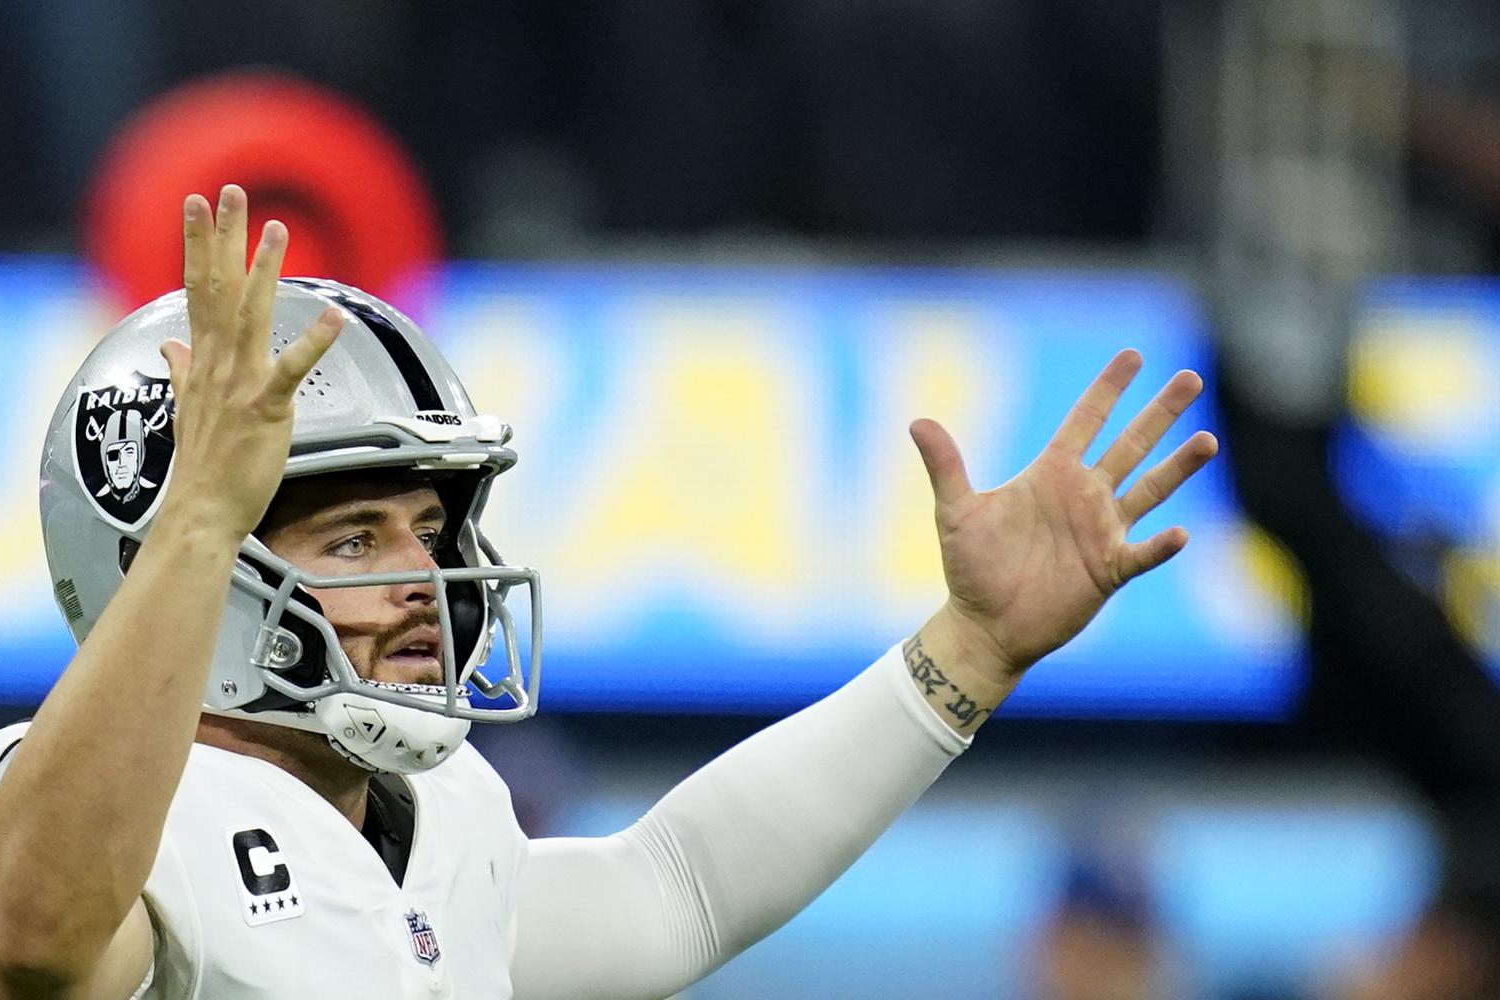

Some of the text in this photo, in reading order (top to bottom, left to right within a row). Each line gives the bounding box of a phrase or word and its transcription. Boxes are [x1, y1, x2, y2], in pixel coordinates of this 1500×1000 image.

[86, 383, 176, 411] RAIDERS
[232, 827, 293, 897] C
[415, 930, 438, 957] NFL
